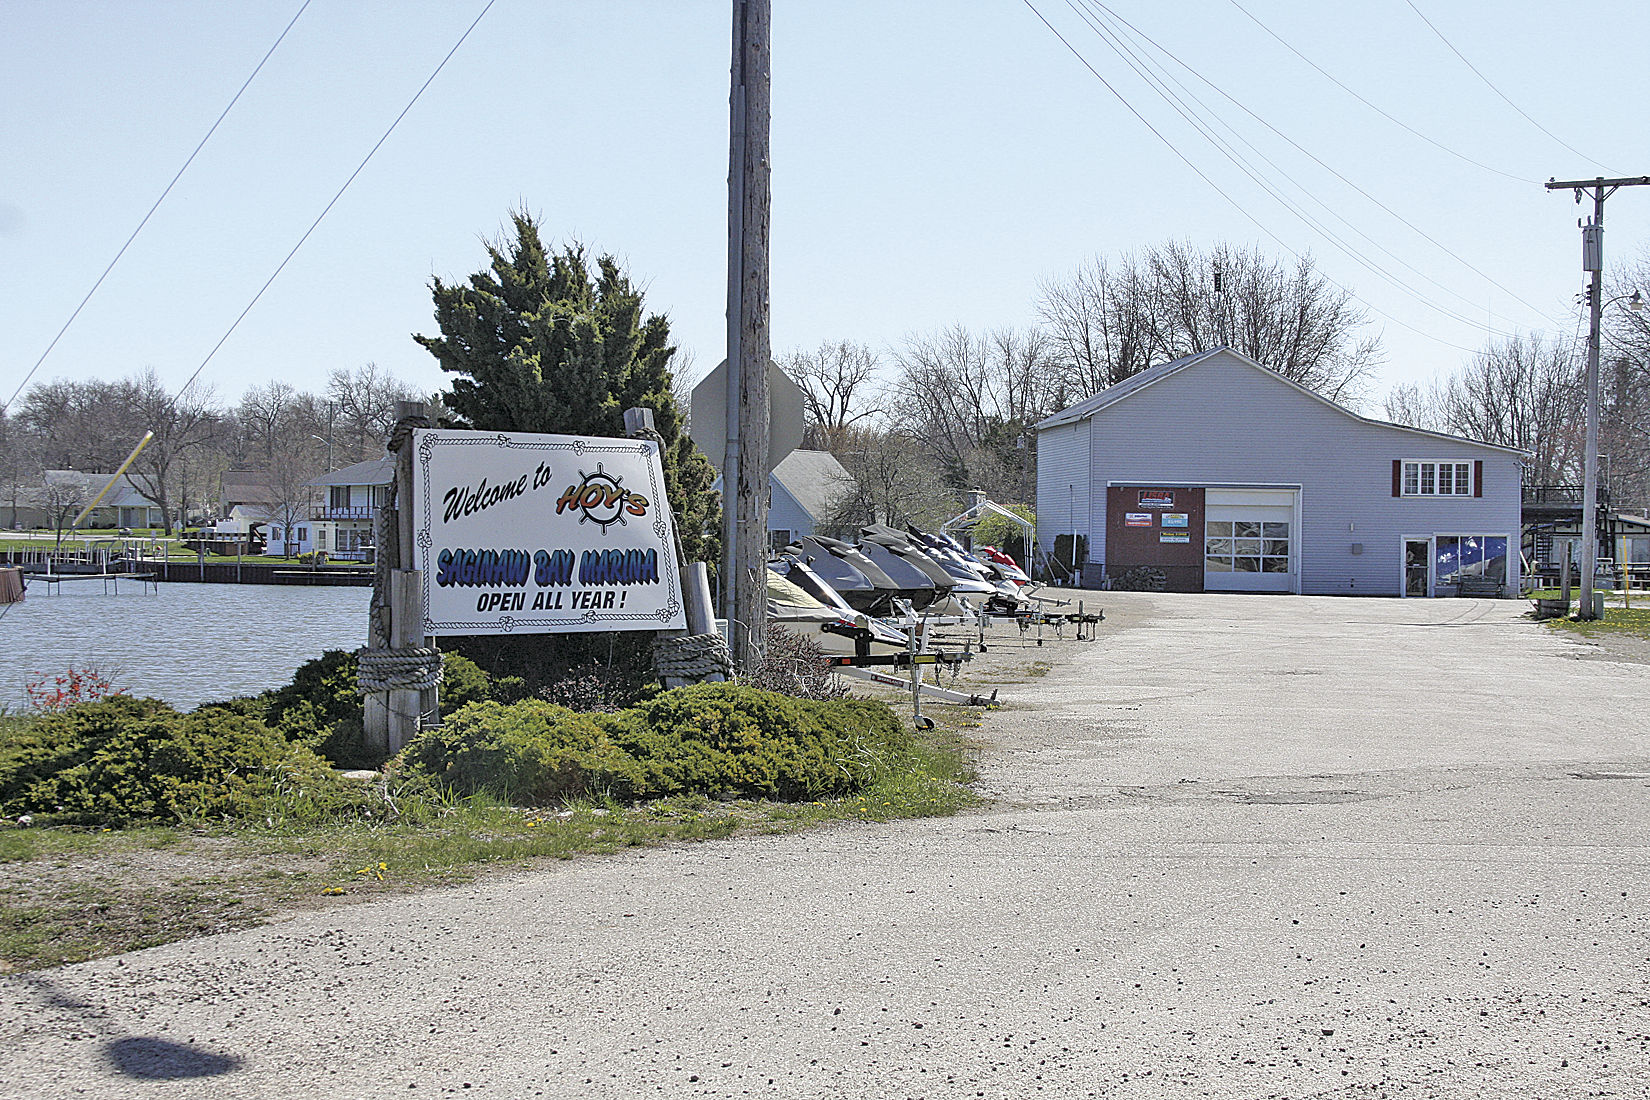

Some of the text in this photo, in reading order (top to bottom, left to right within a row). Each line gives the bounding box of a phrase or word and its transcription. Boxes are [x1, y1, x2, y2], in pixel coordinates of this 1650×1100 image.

[443, 461, 553, 523] Welcome to
[556, 484, 649, 516] HOY'S
[436, 548, 660, 587] SAGINAW BAY MARINA
[477, 592, 524, 612] OPEN
[531, 592, 563, 611] ALL
